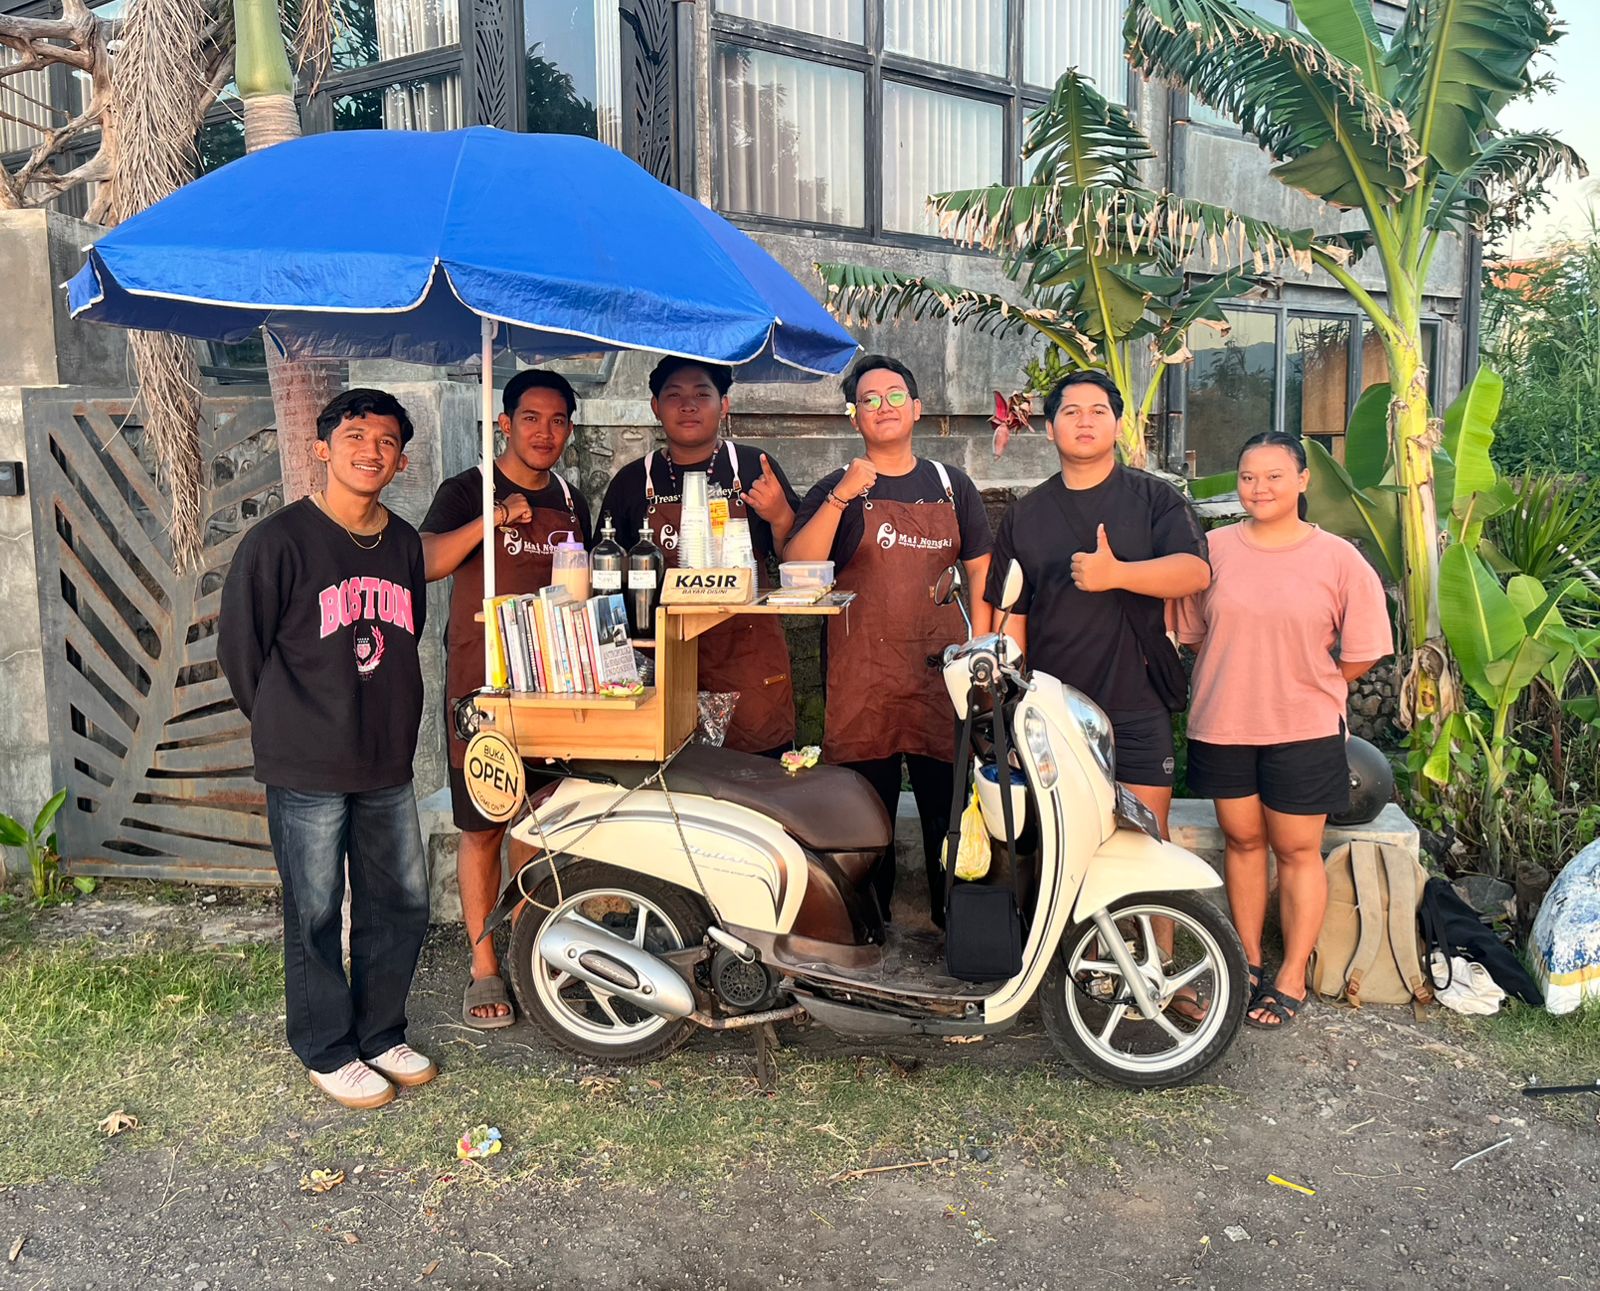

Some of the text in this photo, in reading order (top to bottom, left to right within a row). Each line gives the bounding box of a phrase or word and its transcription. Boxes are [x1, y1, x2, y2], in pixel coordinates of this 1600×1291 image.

[654, 494, 683, 504] Treas
[675, 575, 737, 588] KASIR
[319, 576, 415, 639] BOSTON
[483, 744, 505, 761] BUKA
[469, 757, 518, 798] OPEN
